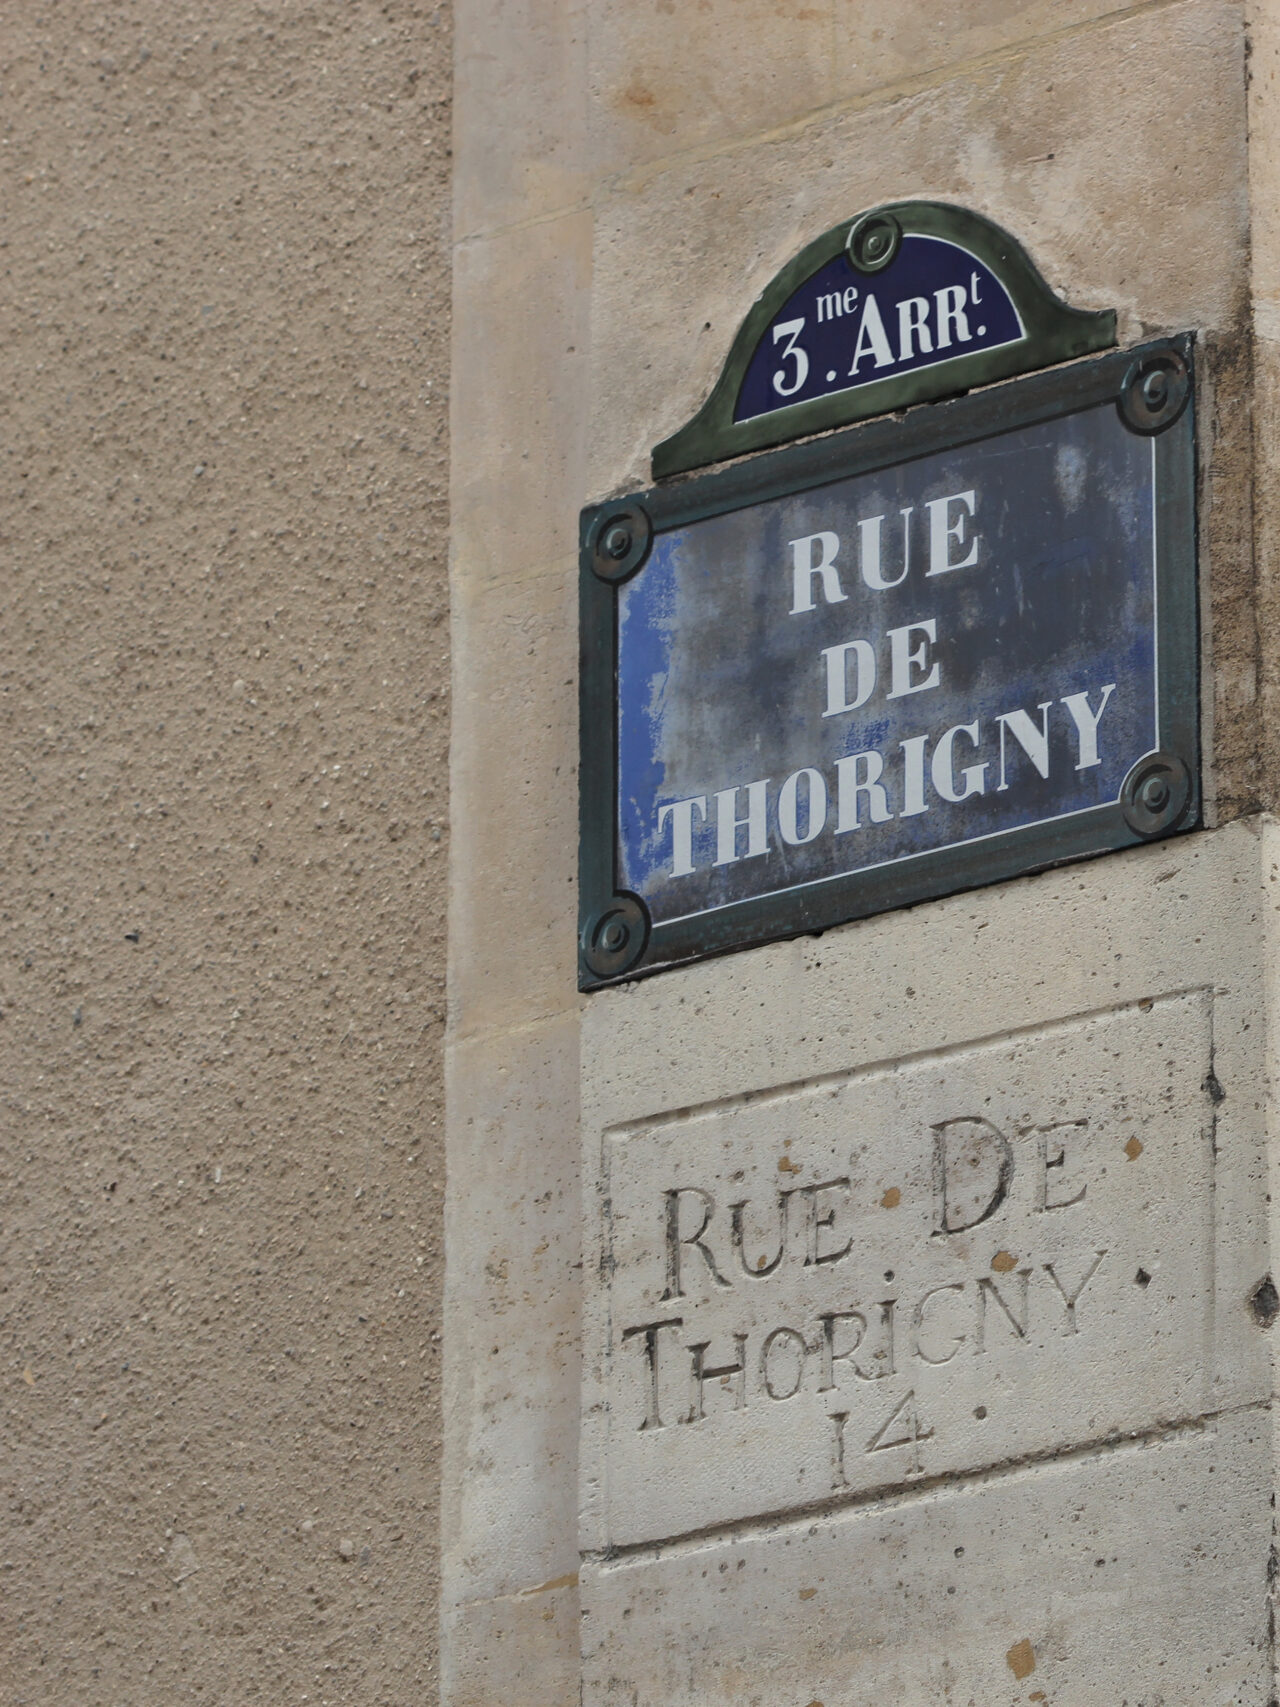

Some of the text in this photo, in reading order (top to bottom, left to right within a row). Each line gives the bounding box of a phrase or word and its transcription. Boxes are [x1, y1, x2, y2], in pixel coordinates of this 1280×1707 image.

[788, 490, 979, 615] RUE
[821, 618, 940, 718] DE
[658, 683, 1116, 878] THORIGNY
[658, 1116, 1089, 1303] RUE DE
[621, 1249, 1107, 1432] THORIGNY
